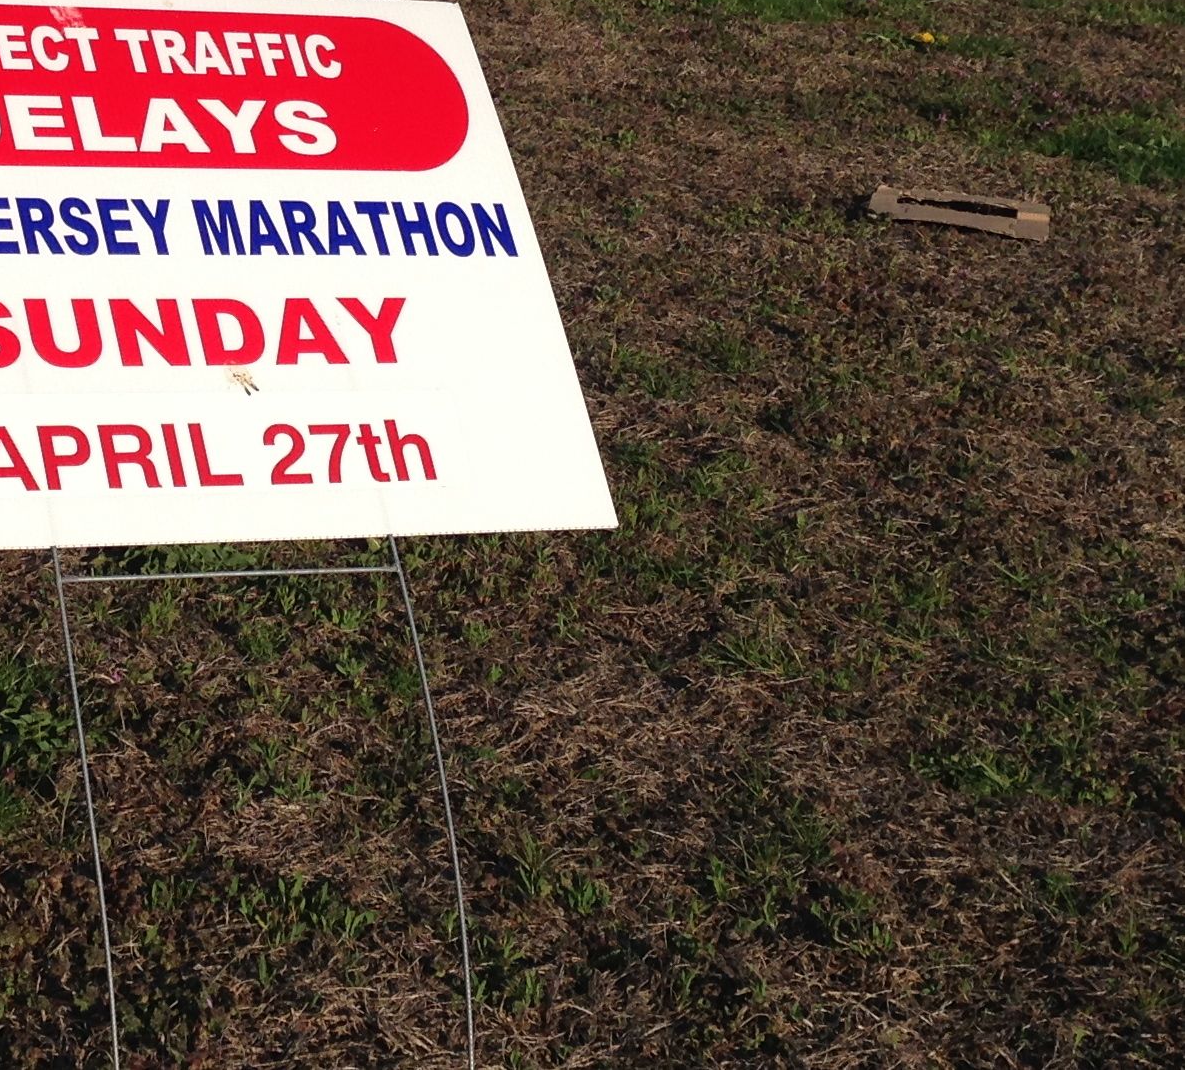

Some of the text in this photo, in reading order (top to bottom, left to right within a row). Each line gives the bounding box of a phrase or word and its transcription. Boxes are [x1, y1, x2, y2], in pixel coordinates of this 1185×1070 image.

[114, 28, 342, 79] TRAFFIC
[192, 200, 519, 258] MARATHON
[262, 420, 437, 485] 27th
